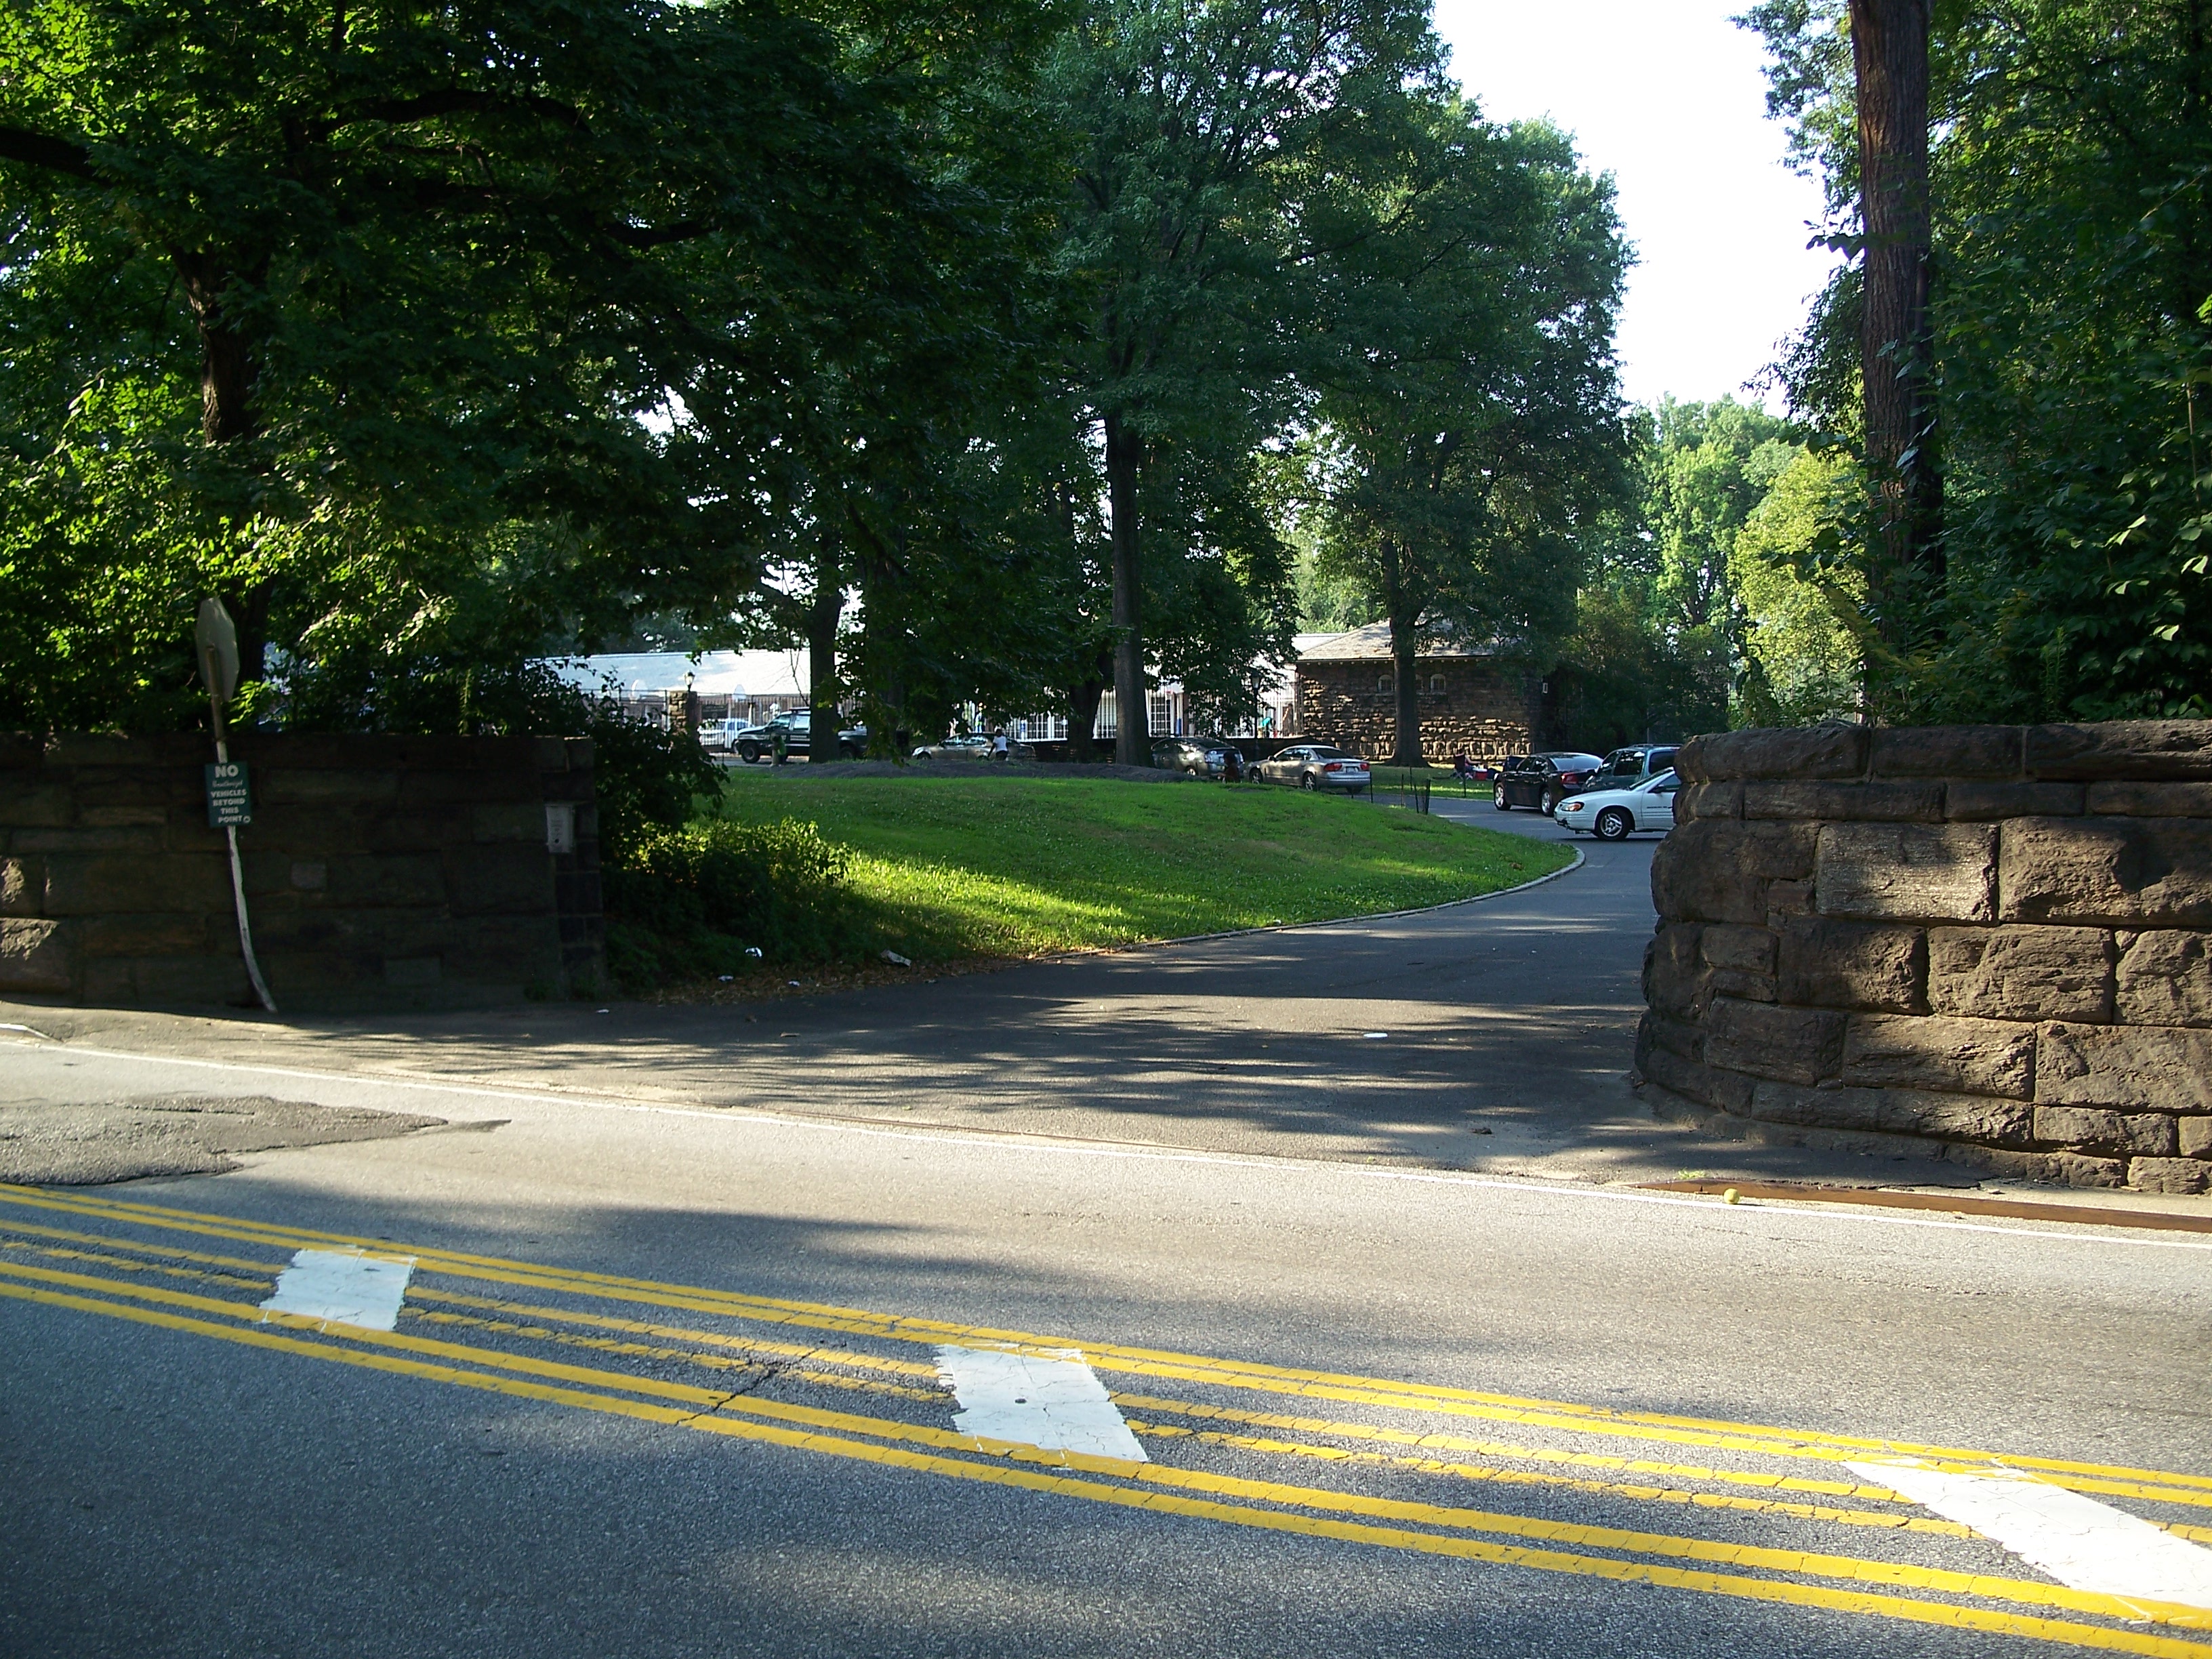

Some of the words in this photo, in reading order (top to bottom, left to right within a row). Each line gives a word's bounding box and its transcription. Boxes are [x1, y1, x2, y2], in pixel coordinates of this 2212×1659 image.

[215, 765, 239, 778] NO
[210, 789, 247, 798] VEHICLES
[213, 798, 245, 806] BEYOND
[218, 815, 243, 823] POINT
